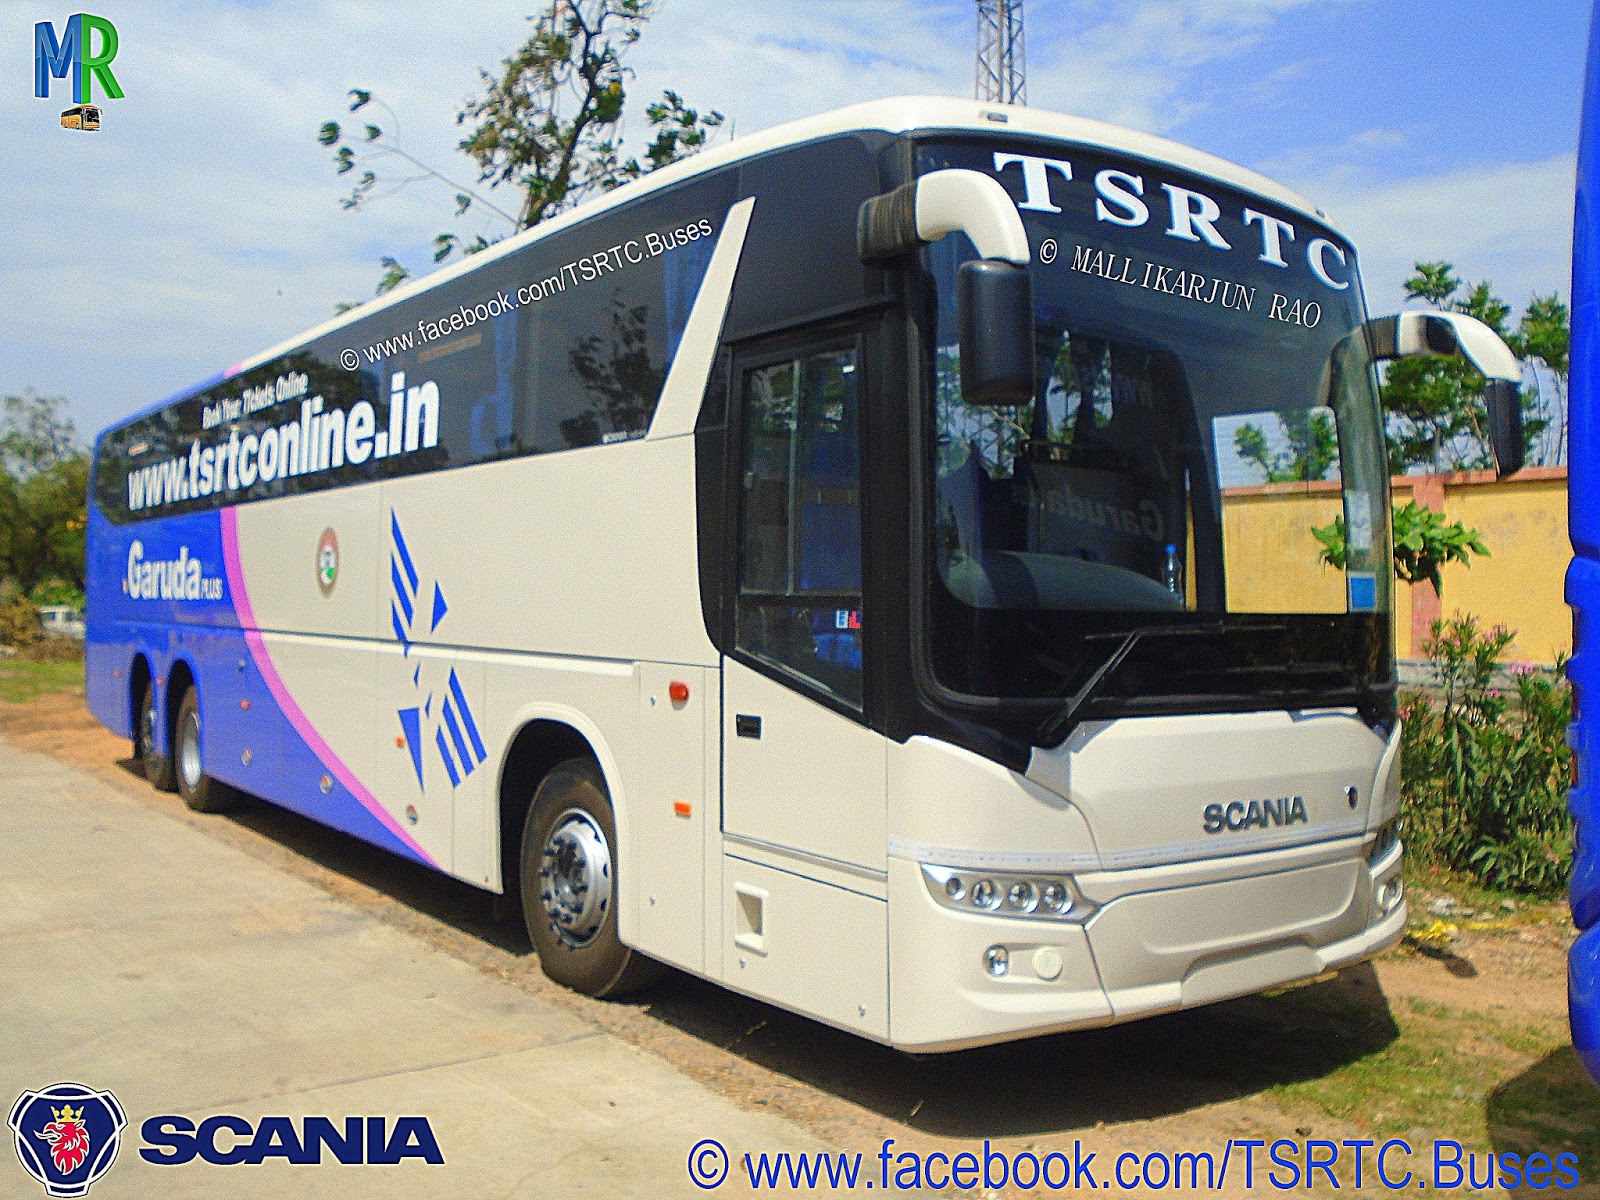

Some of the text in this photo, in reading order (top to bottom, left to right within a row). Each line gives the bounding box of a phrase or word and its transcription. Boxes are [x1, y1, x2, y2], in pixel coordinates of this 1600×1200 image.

[993, 152, 1350, 291] TSRTC
[276, 371, 309, 402] Online
[128, 371, 440, 511] www.tsrtconline.in
[128, 540, 201, 600] Garuda
[1203, 796, 1308, 834] SCANIA
